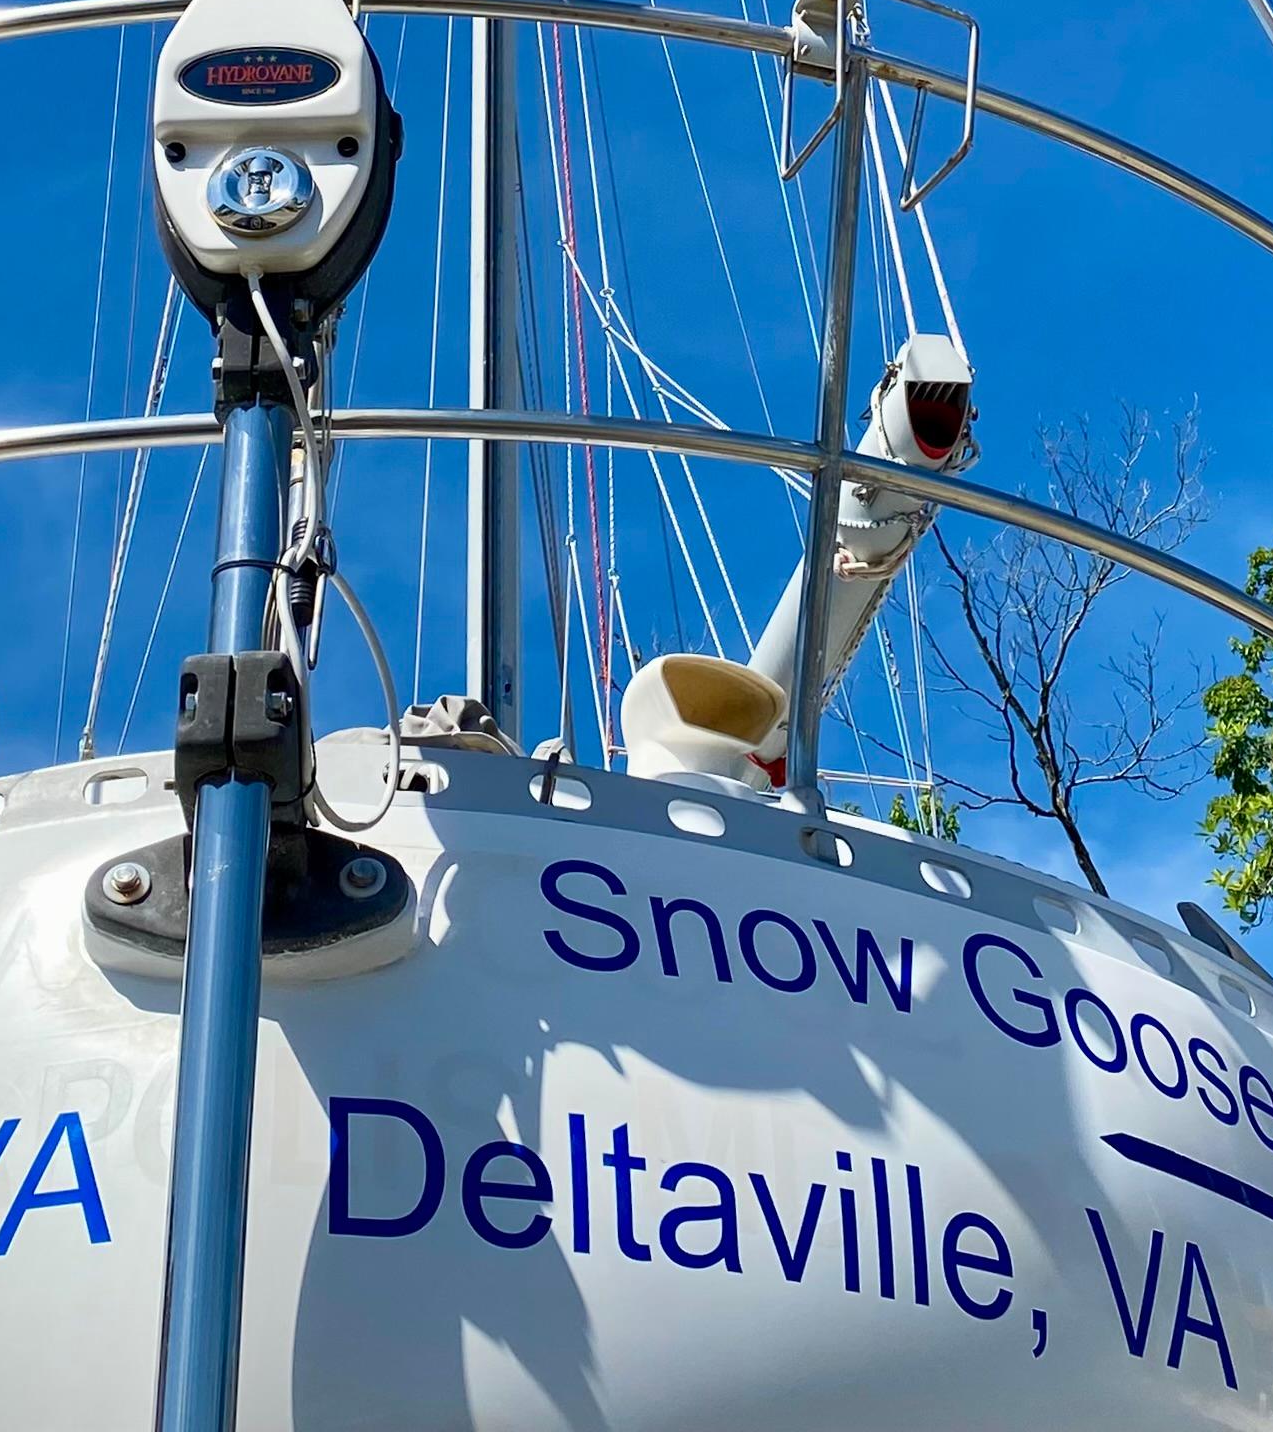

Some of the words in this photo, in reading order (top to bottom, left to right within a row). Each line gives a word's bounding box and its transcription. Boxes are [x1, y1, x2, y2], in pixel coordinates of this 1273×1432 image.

[207, 63, 314, 86] HYDROVANE
[540, 859, 915, 1014] Snow
[328, 1097, 1050, 1360] Deltaville,
[1083, 1207, 1239, 1390] VA
